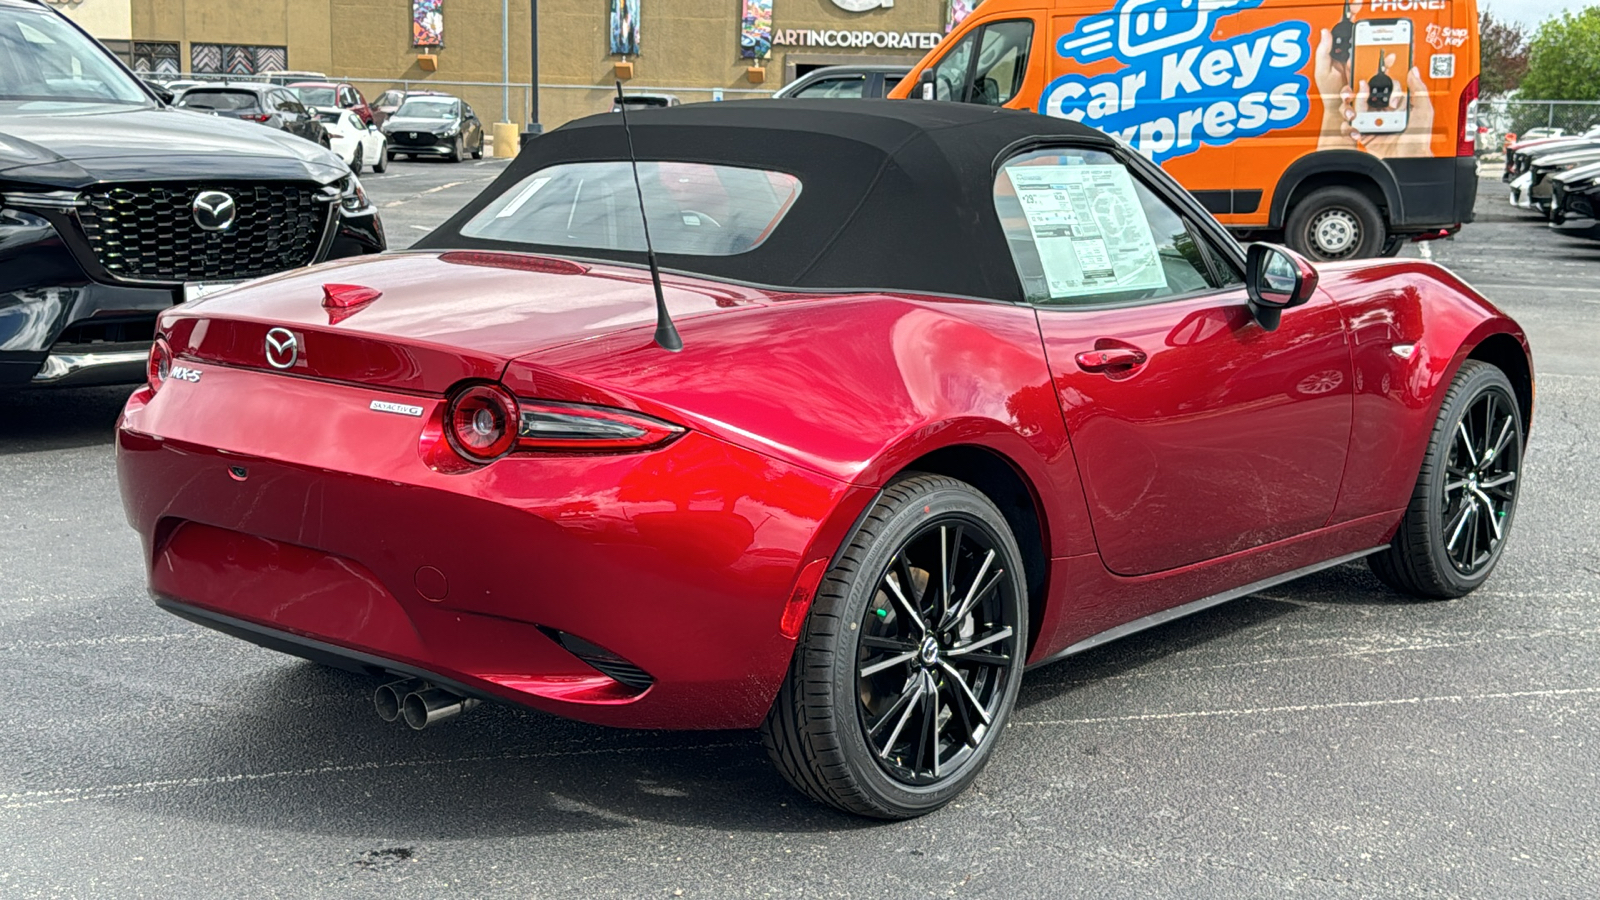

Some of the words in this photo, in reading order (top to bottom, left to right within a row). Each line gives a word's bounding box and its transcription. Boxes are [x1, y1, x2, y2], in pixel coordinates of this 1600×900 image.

[1441, 27, 1468, 38] Snap
[1444, 36, 1467, 48] Key
[1046, 70, 1147, 122] Car
[1160, 29, 1302, 101] Keys
[171, 366, 203, 383] MX-5
